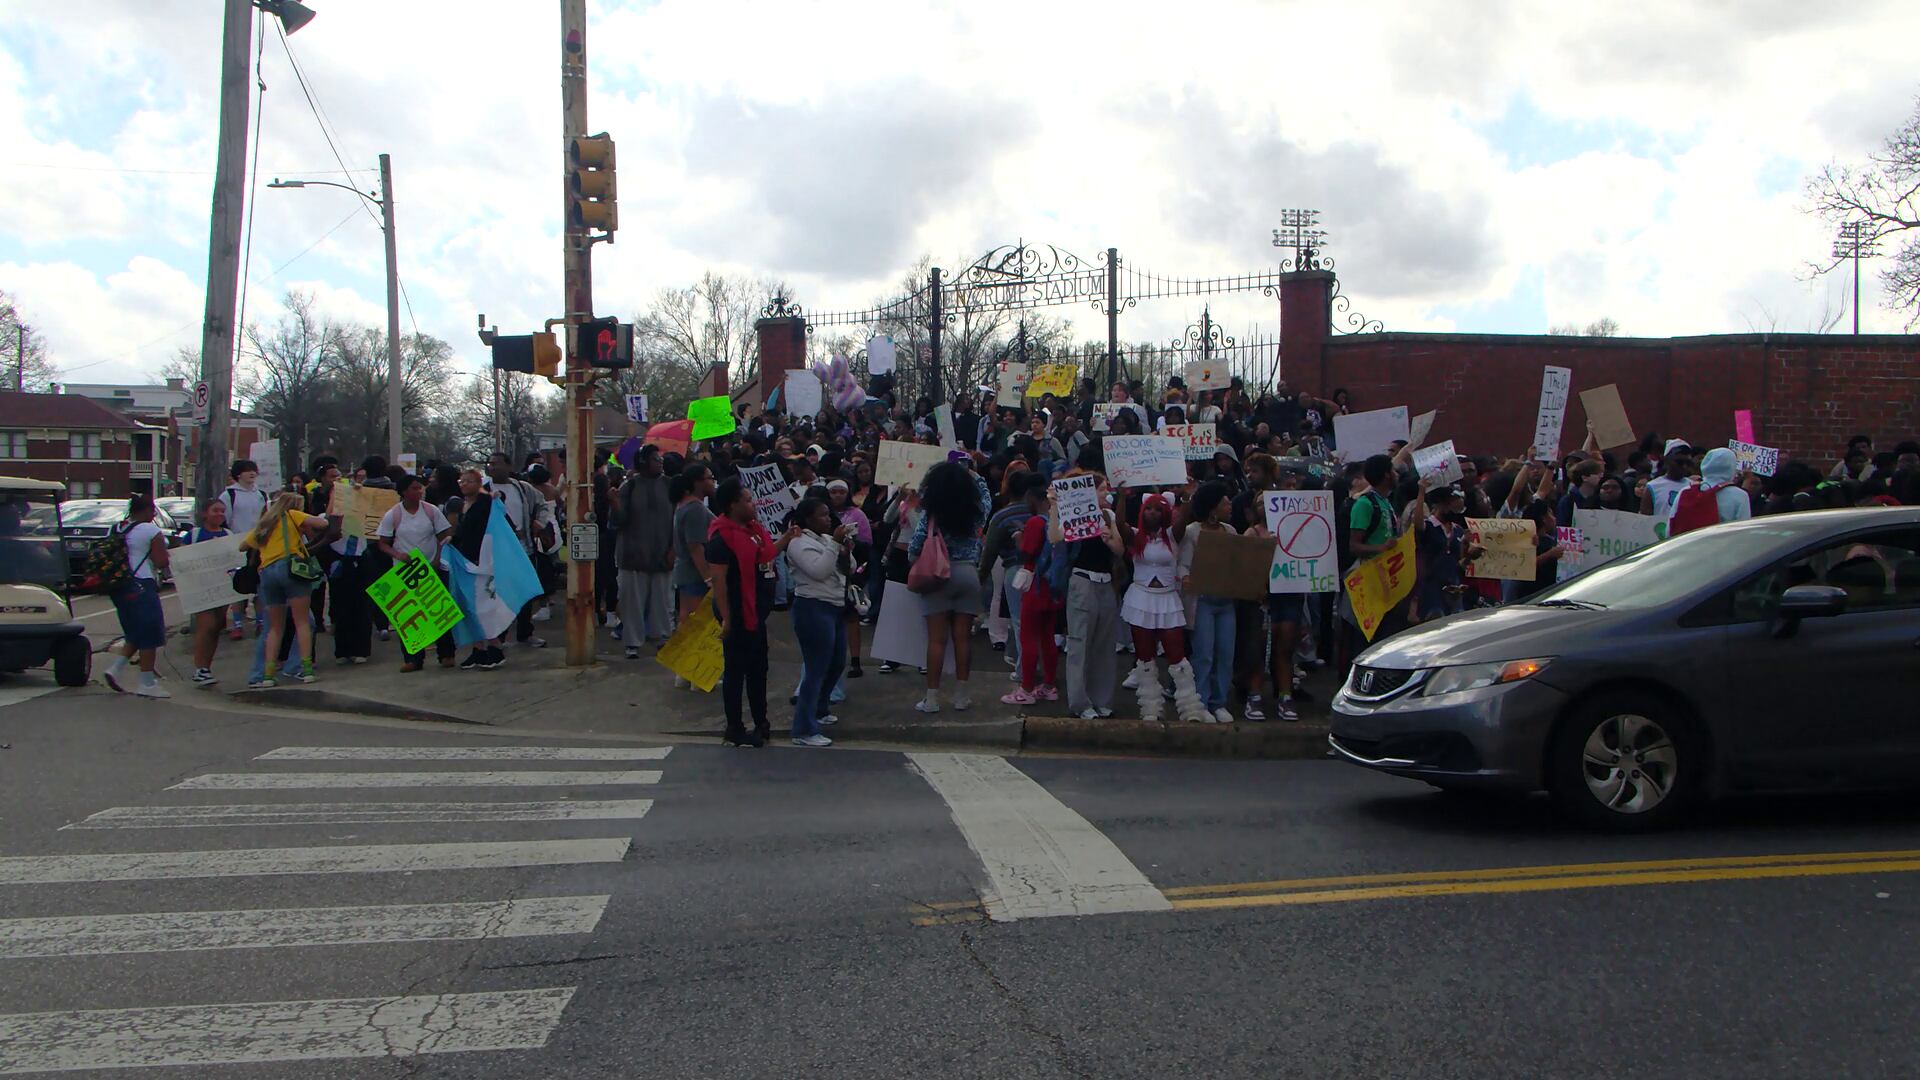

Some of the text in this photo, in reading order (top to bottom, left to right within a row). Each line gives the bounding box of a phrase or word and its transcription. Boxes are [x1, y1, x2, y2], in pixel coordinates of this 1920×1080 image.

[1033, 276, 1105, 301] STADIUM
[1730, 441, 1740, 450] BE
[1054, 476, 1094, 493] NO ONE
[1271, 559, 1318, 579] MELT
[1310, 575, 1335, 592] ICE
[395, 557, 461, 631] ABOLISH
[386, 589, 429, 640] ICE
